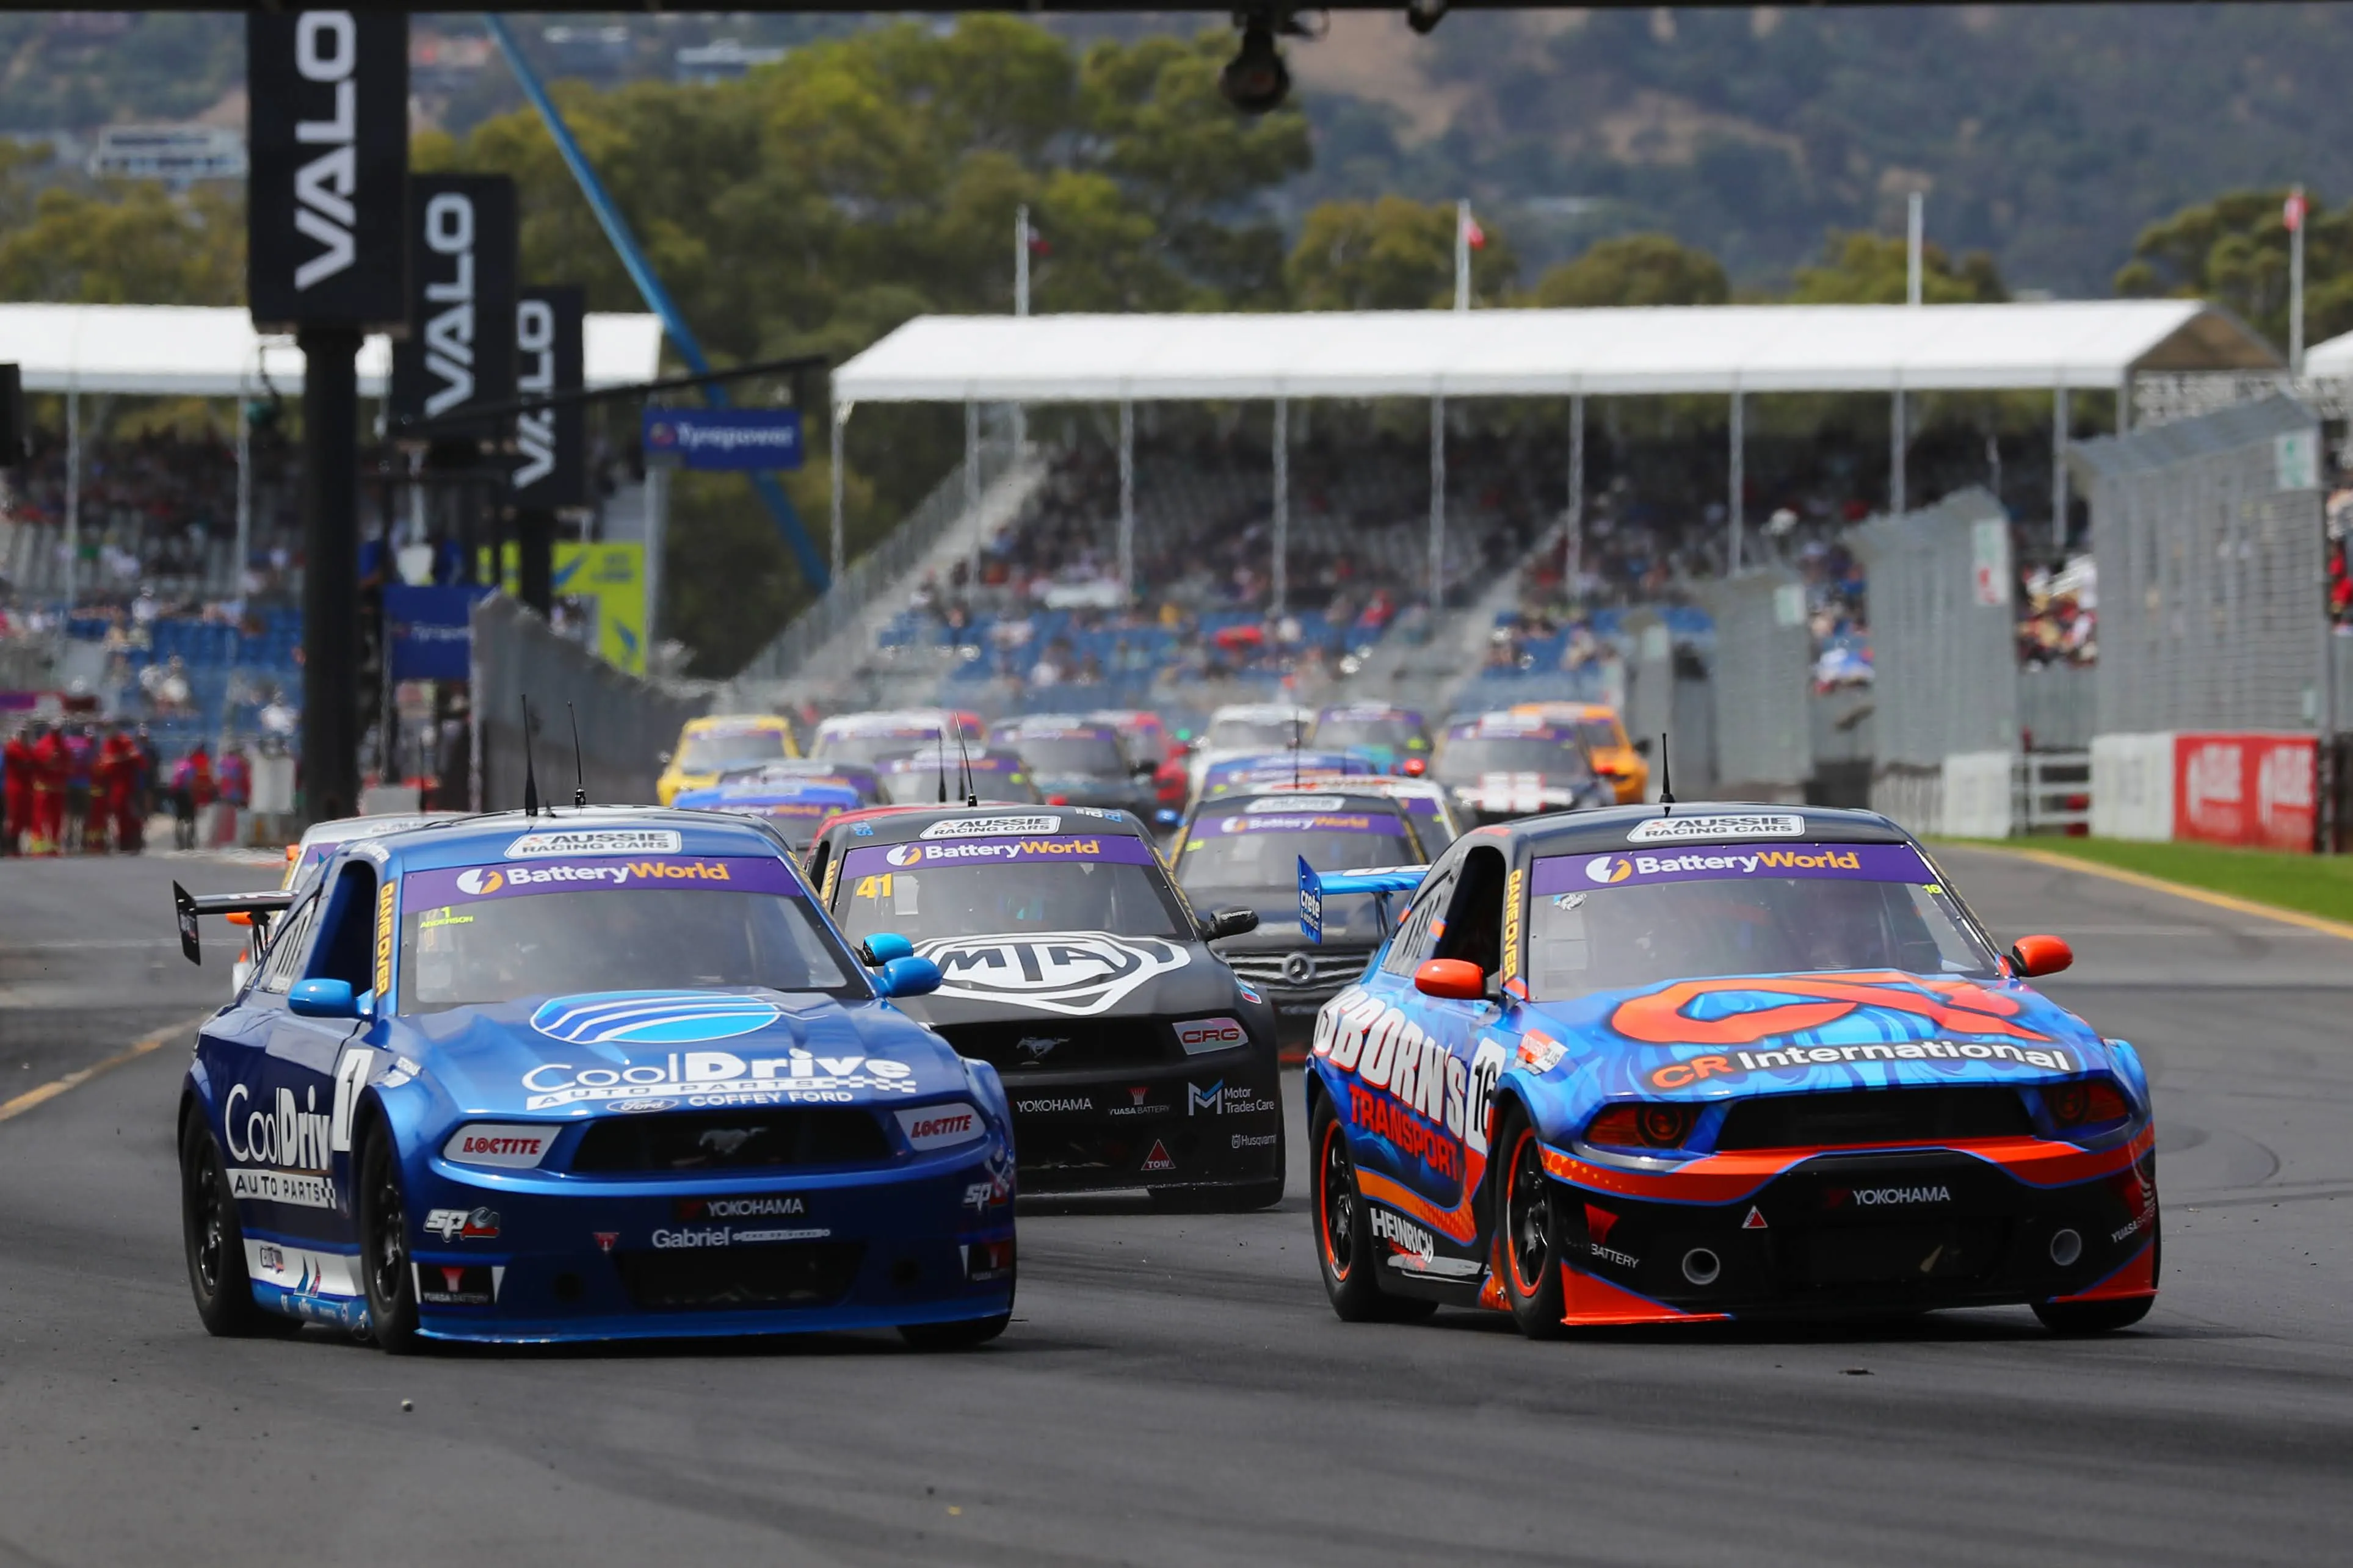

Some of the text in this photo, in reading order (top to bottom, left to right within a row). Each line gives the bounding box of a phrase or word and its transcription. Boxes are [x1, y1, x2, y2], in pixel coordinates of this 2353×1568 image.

[295, 10, 357, 292] VALO
[424, 192, 476, 416] VALO
[513, 299, 555, 488] VALO
[934, 823, 1050, 836] RACING CARS
[959, 817, 1051, 828] AUSSIE
[1645, 824, 1793, 837] RACING CARS
[1673, 816, 1791, 828] AUSSIE
[523, 840, 670, 853] RACING CARS
[552, 832, 669, 844] AUSSIE
[856, 873, 893, 898] 41
[1922, 883, 1941, 895] 16
[1181, 1028, 1241, 1044] CRG
[521, 1047, 912, 1093] CoolDrive
[1651, 1040, 2072, 1089] CR International
[540, 1079, 814, 1107] AUTO PARTS
[620, 1090, 854, 1111] Ford COFFEY FORD
[1224, 1086, 1252, 1100] Motor
[1474, 1056, 1498, 1140] 16
[1017, 1097, 1093, 1113] YOKOHAMA
[1137, 1105, 1171, 1115] BATTERY
[1225, 1099, 1275, 1114] Trades Care
[225, 1083, 333, 1171] CoolDriv
[911, 1114, 973, 1139] LOCTITE
[1348, 1083, 1460, 1182] TRANSPORT
[463, 1136, 542, 1156] LOCTITE
[1148, 1160, 1170, 1169] TOW
[234, 1174, 321, 1202] AUTO PARTS
[1853, 1186, 1951, 1205] YOKOHAMA
[707, 1198, 804, 1217] YOKOHAMA
[651, 1226, 731, 1249] Gabriel
[1370, 1207, 1435, 1263] HEINRICH
[1590, 1243, 1640, 1269] BATTERY
